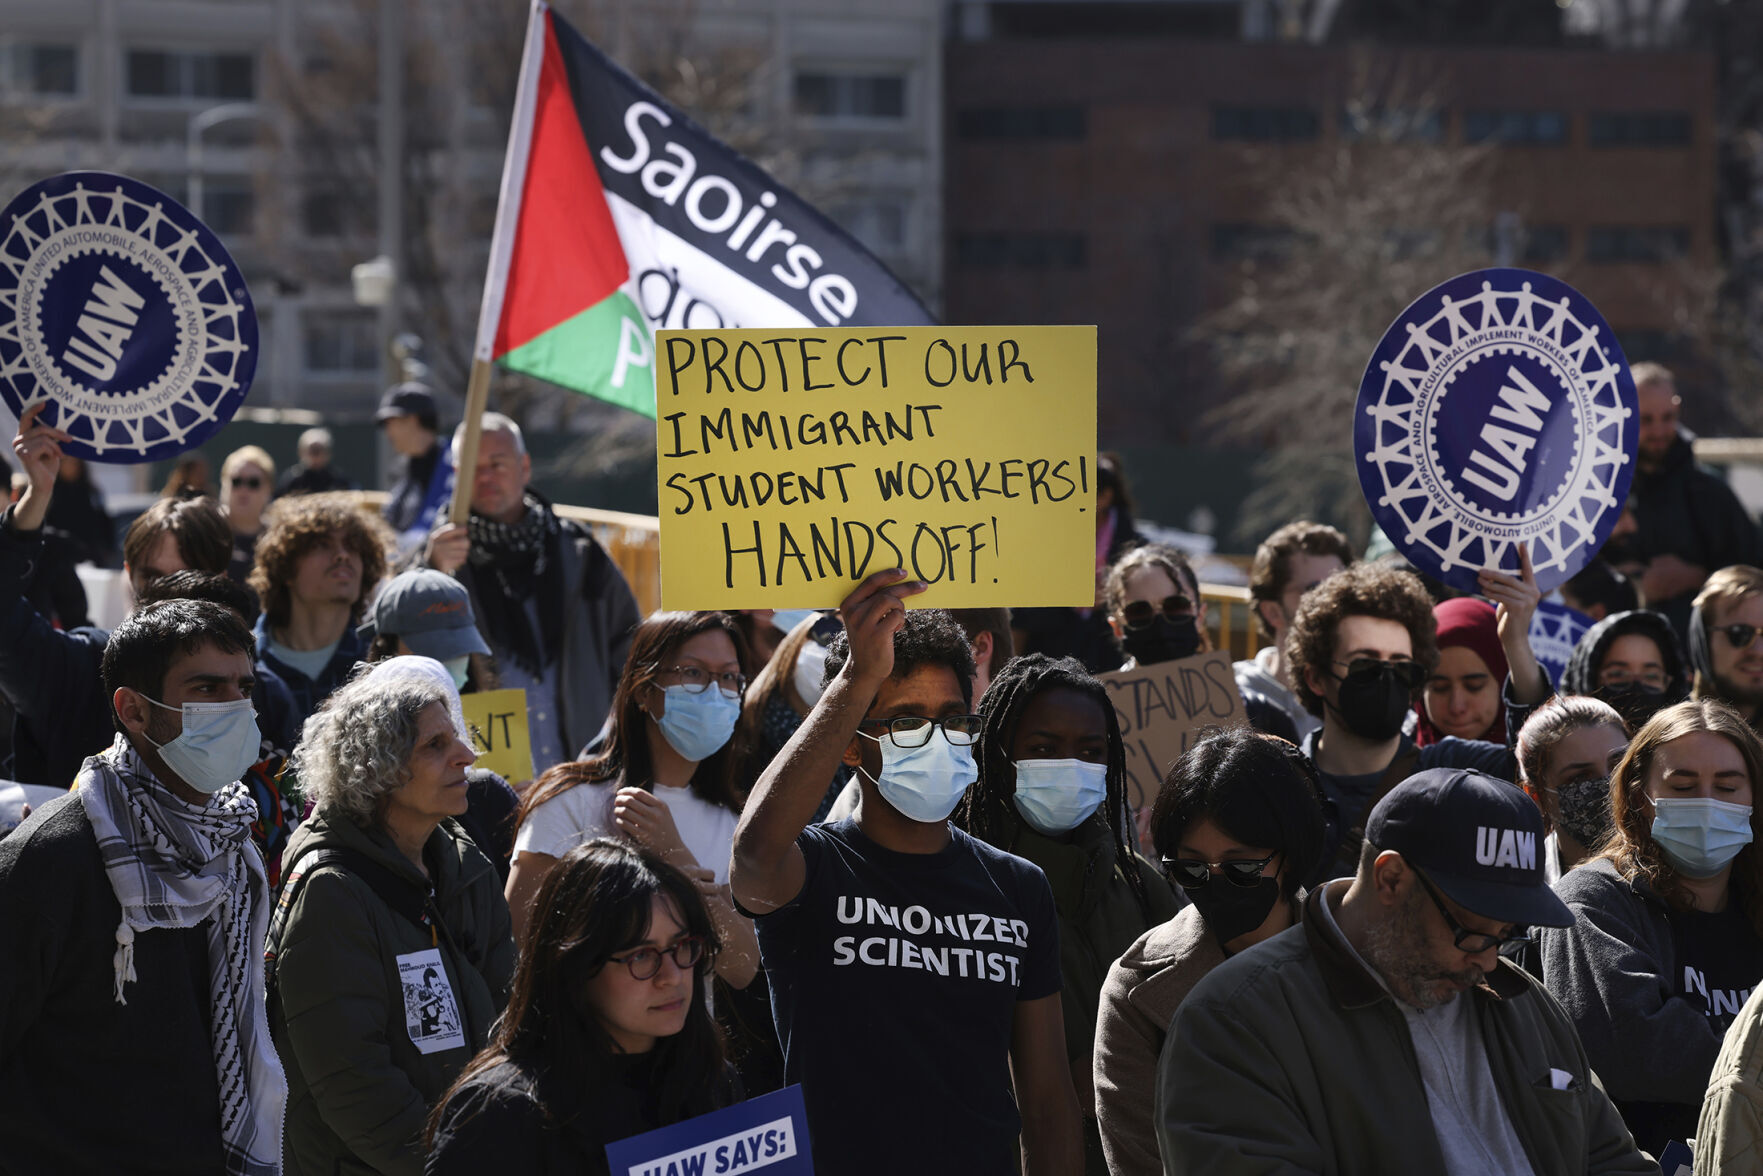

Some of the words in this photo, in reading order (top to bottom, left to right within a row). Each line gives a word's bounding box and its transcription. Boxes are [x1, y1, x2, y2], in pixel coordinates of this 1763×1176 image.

[600, 101, 858, 327] Saoirse
[33, 243, 61, 278] UNITED
[140, 248, 193, 308] AEROSPACE
[22, 279, 36, 332] AMERICA
[62, 264, 146, 382] UAW
[184, 309, 199, 336] AND
[26, 332, 38, 353] OF
[665, 336, 907, 395] PROTECT
[925, 339, 1035, 388] OUR
[1465, 330, 1524, 349] IMPLEMENT
[1528, 333, 1570, 368] WORKERS
[32, 350, 74, 402] WORKERS
[149, 338, 199, 408] AGRICULTURAL
[1415, 348, 1465, 417] AGRICULTURAL
[1569, 367, 1581, 382] OF
[76, 398, 148, 416] IMPLEMENT
[663, 404, 943, 458] IMMIGRANT
[1413, 420, 1422, 446] AND
[1461, 365, 1552, 501] UAW
[1578, 387, 1594, 436] AMERICA
[666, 463, 856, 515] STUDENT
[875, 456, 1089, 513] WORKERS!
[1415, 452, 1451, 510] AEROSPACE
[1523, 514, 1557, 536] UNITED
[721, 517, 904, 588] HANDS
[911, 516, 1000, 585] OFF!
[1105, 660, 1234, 736] STANDS
[1476, 826, 1536, 870] UAW
[836, 895, 1030, 949] UNIONIZED
[714, 1129, 787, 1175] SAYS:
